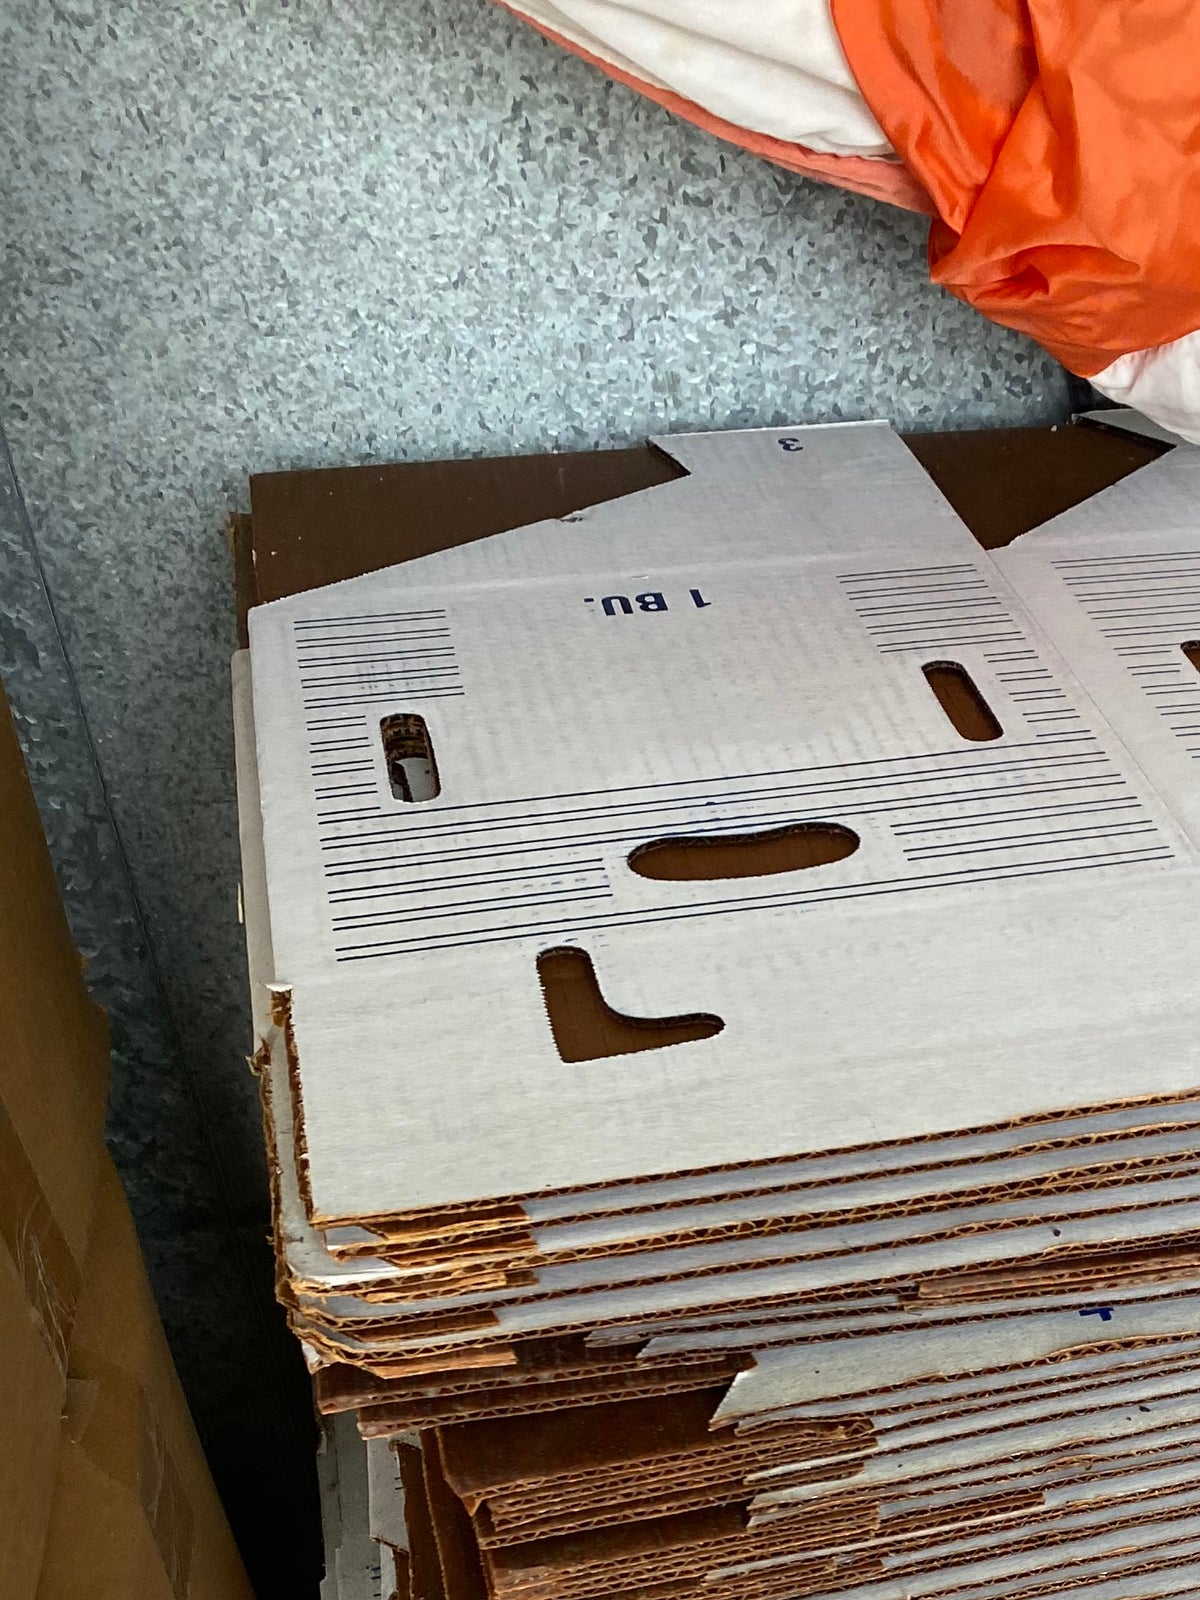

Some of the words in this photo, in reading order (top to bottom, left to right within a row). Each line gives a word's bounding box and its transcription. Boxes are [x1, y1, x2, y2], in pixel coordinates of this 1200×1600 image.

[778, 438, 803, 451] 3
[583, 592, 668, 616] BU.
[689, 589, 712, 608] 1
